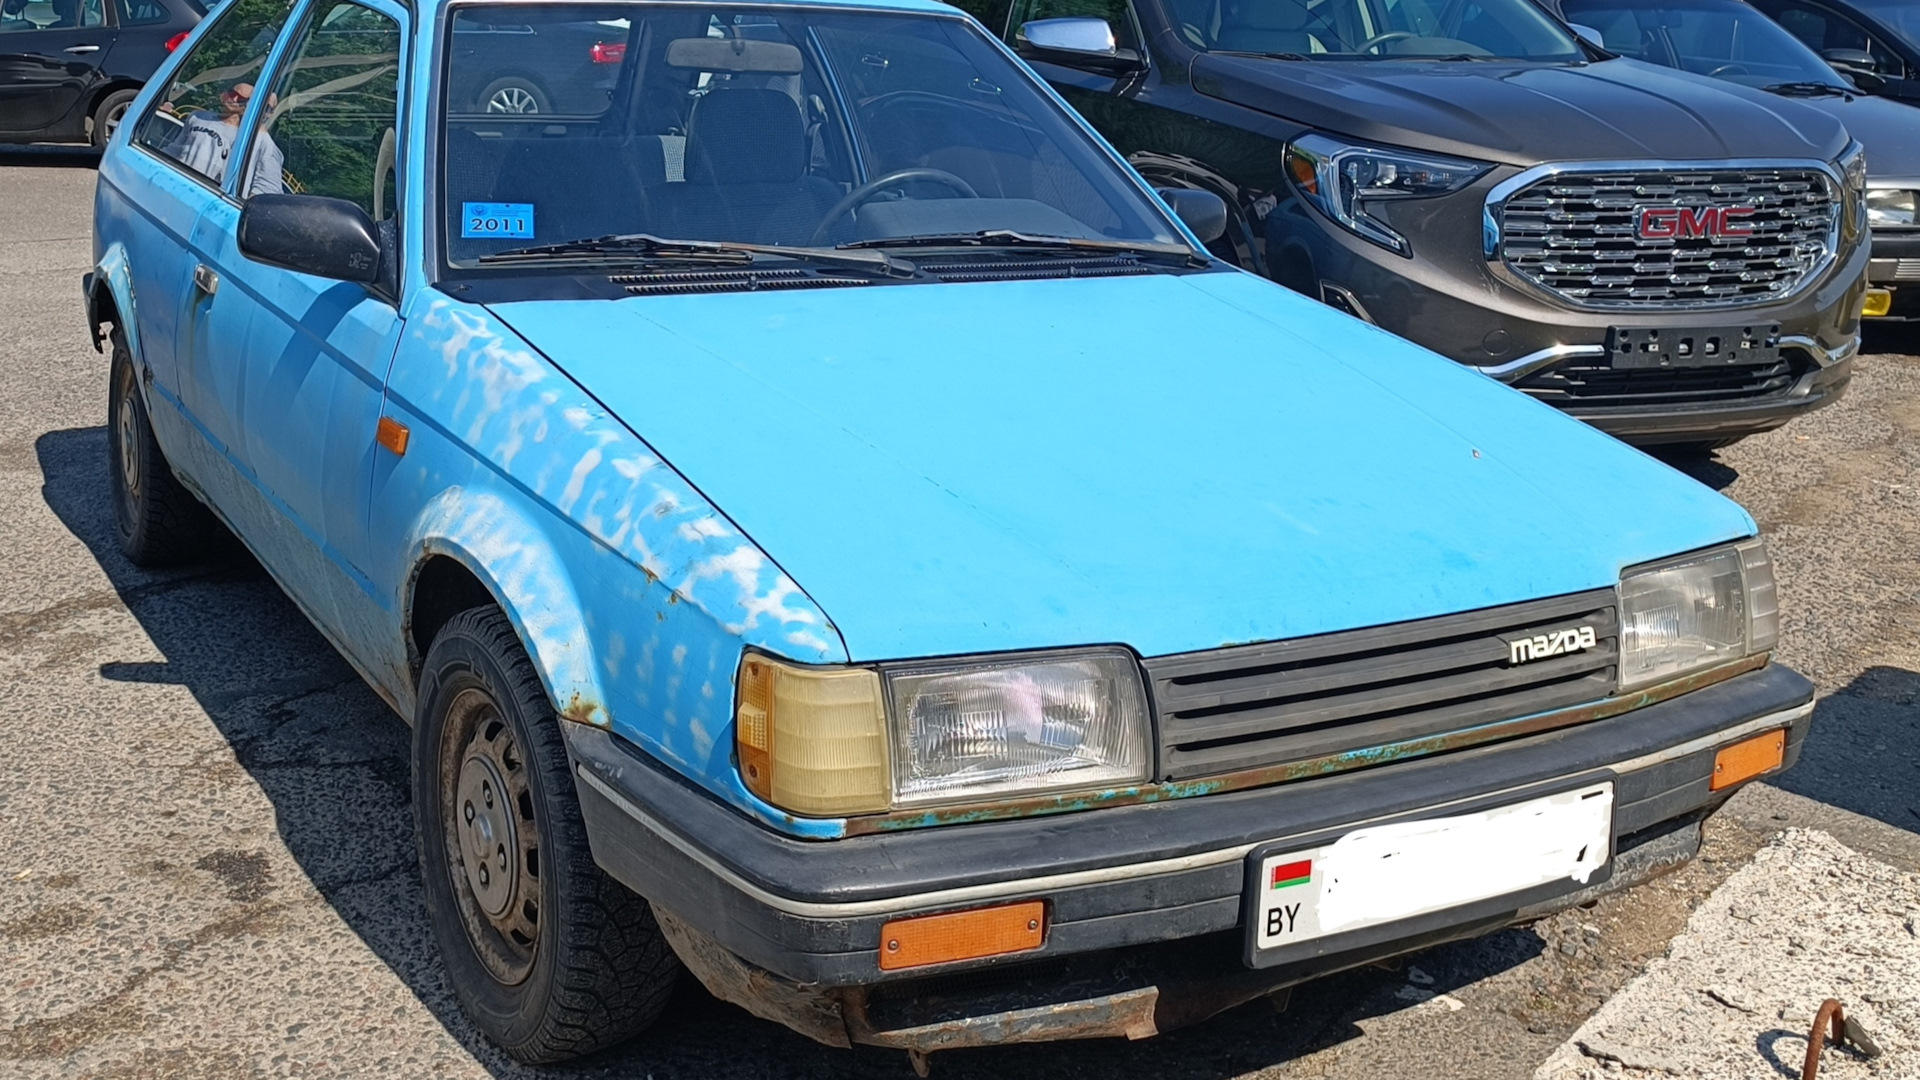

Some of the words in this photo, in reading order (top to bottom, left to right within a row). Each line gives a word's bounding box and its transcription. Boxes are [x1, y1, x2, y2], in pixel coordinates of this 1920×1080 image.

[471, 218, 523, 231] 2011
[1640, 206, 1756, 238] GMC
[1267, 903, 1301, 937] BY
